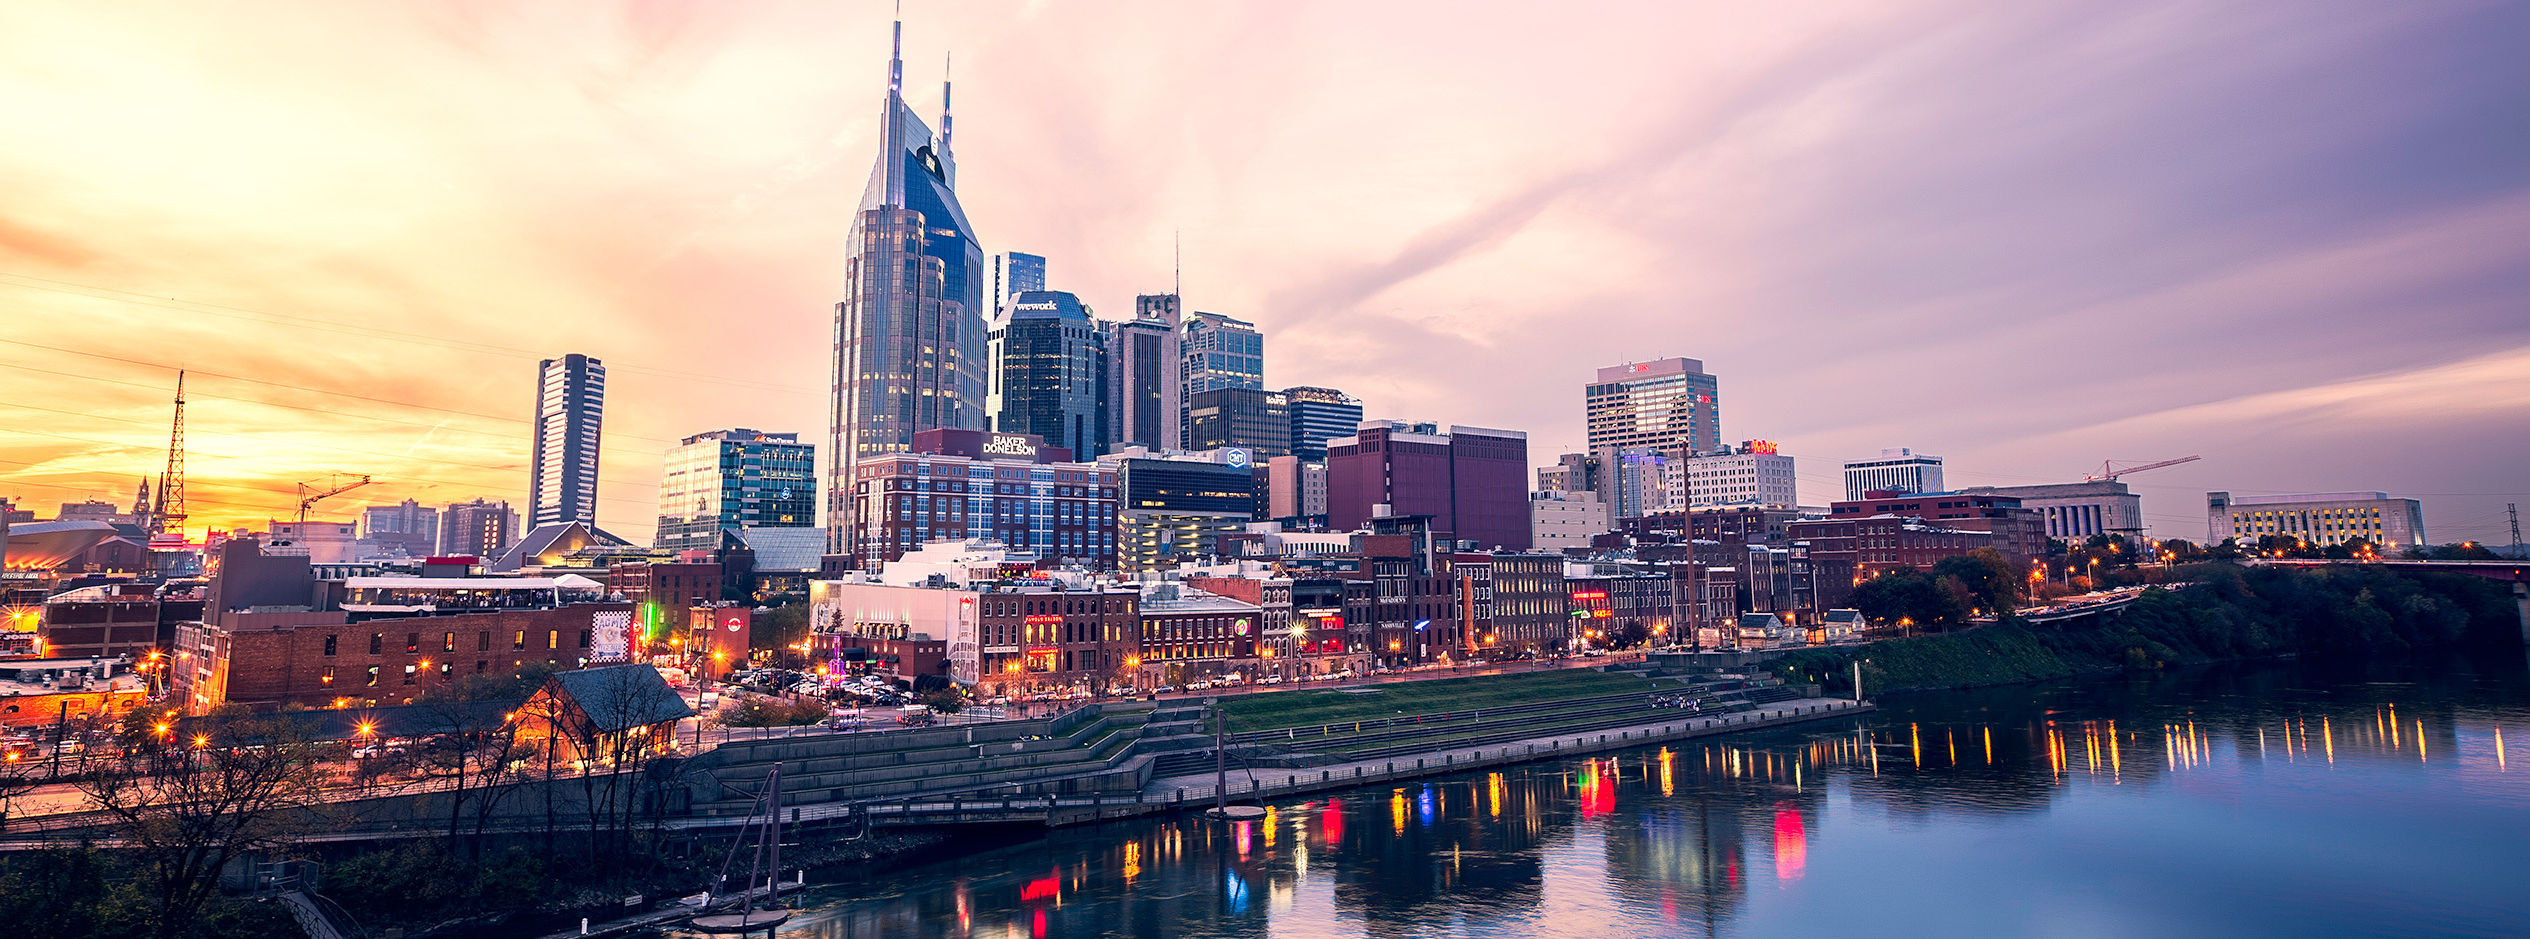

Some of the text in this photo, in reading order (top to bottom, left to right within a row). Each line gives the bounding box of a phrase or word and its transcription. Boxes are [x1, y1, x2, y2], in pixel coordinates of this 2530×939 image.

[1016, 300, 1057, 311] wework
[993, 436, 1026, 447] BAKER
[983, 443, 1036, 456] DONELSON
